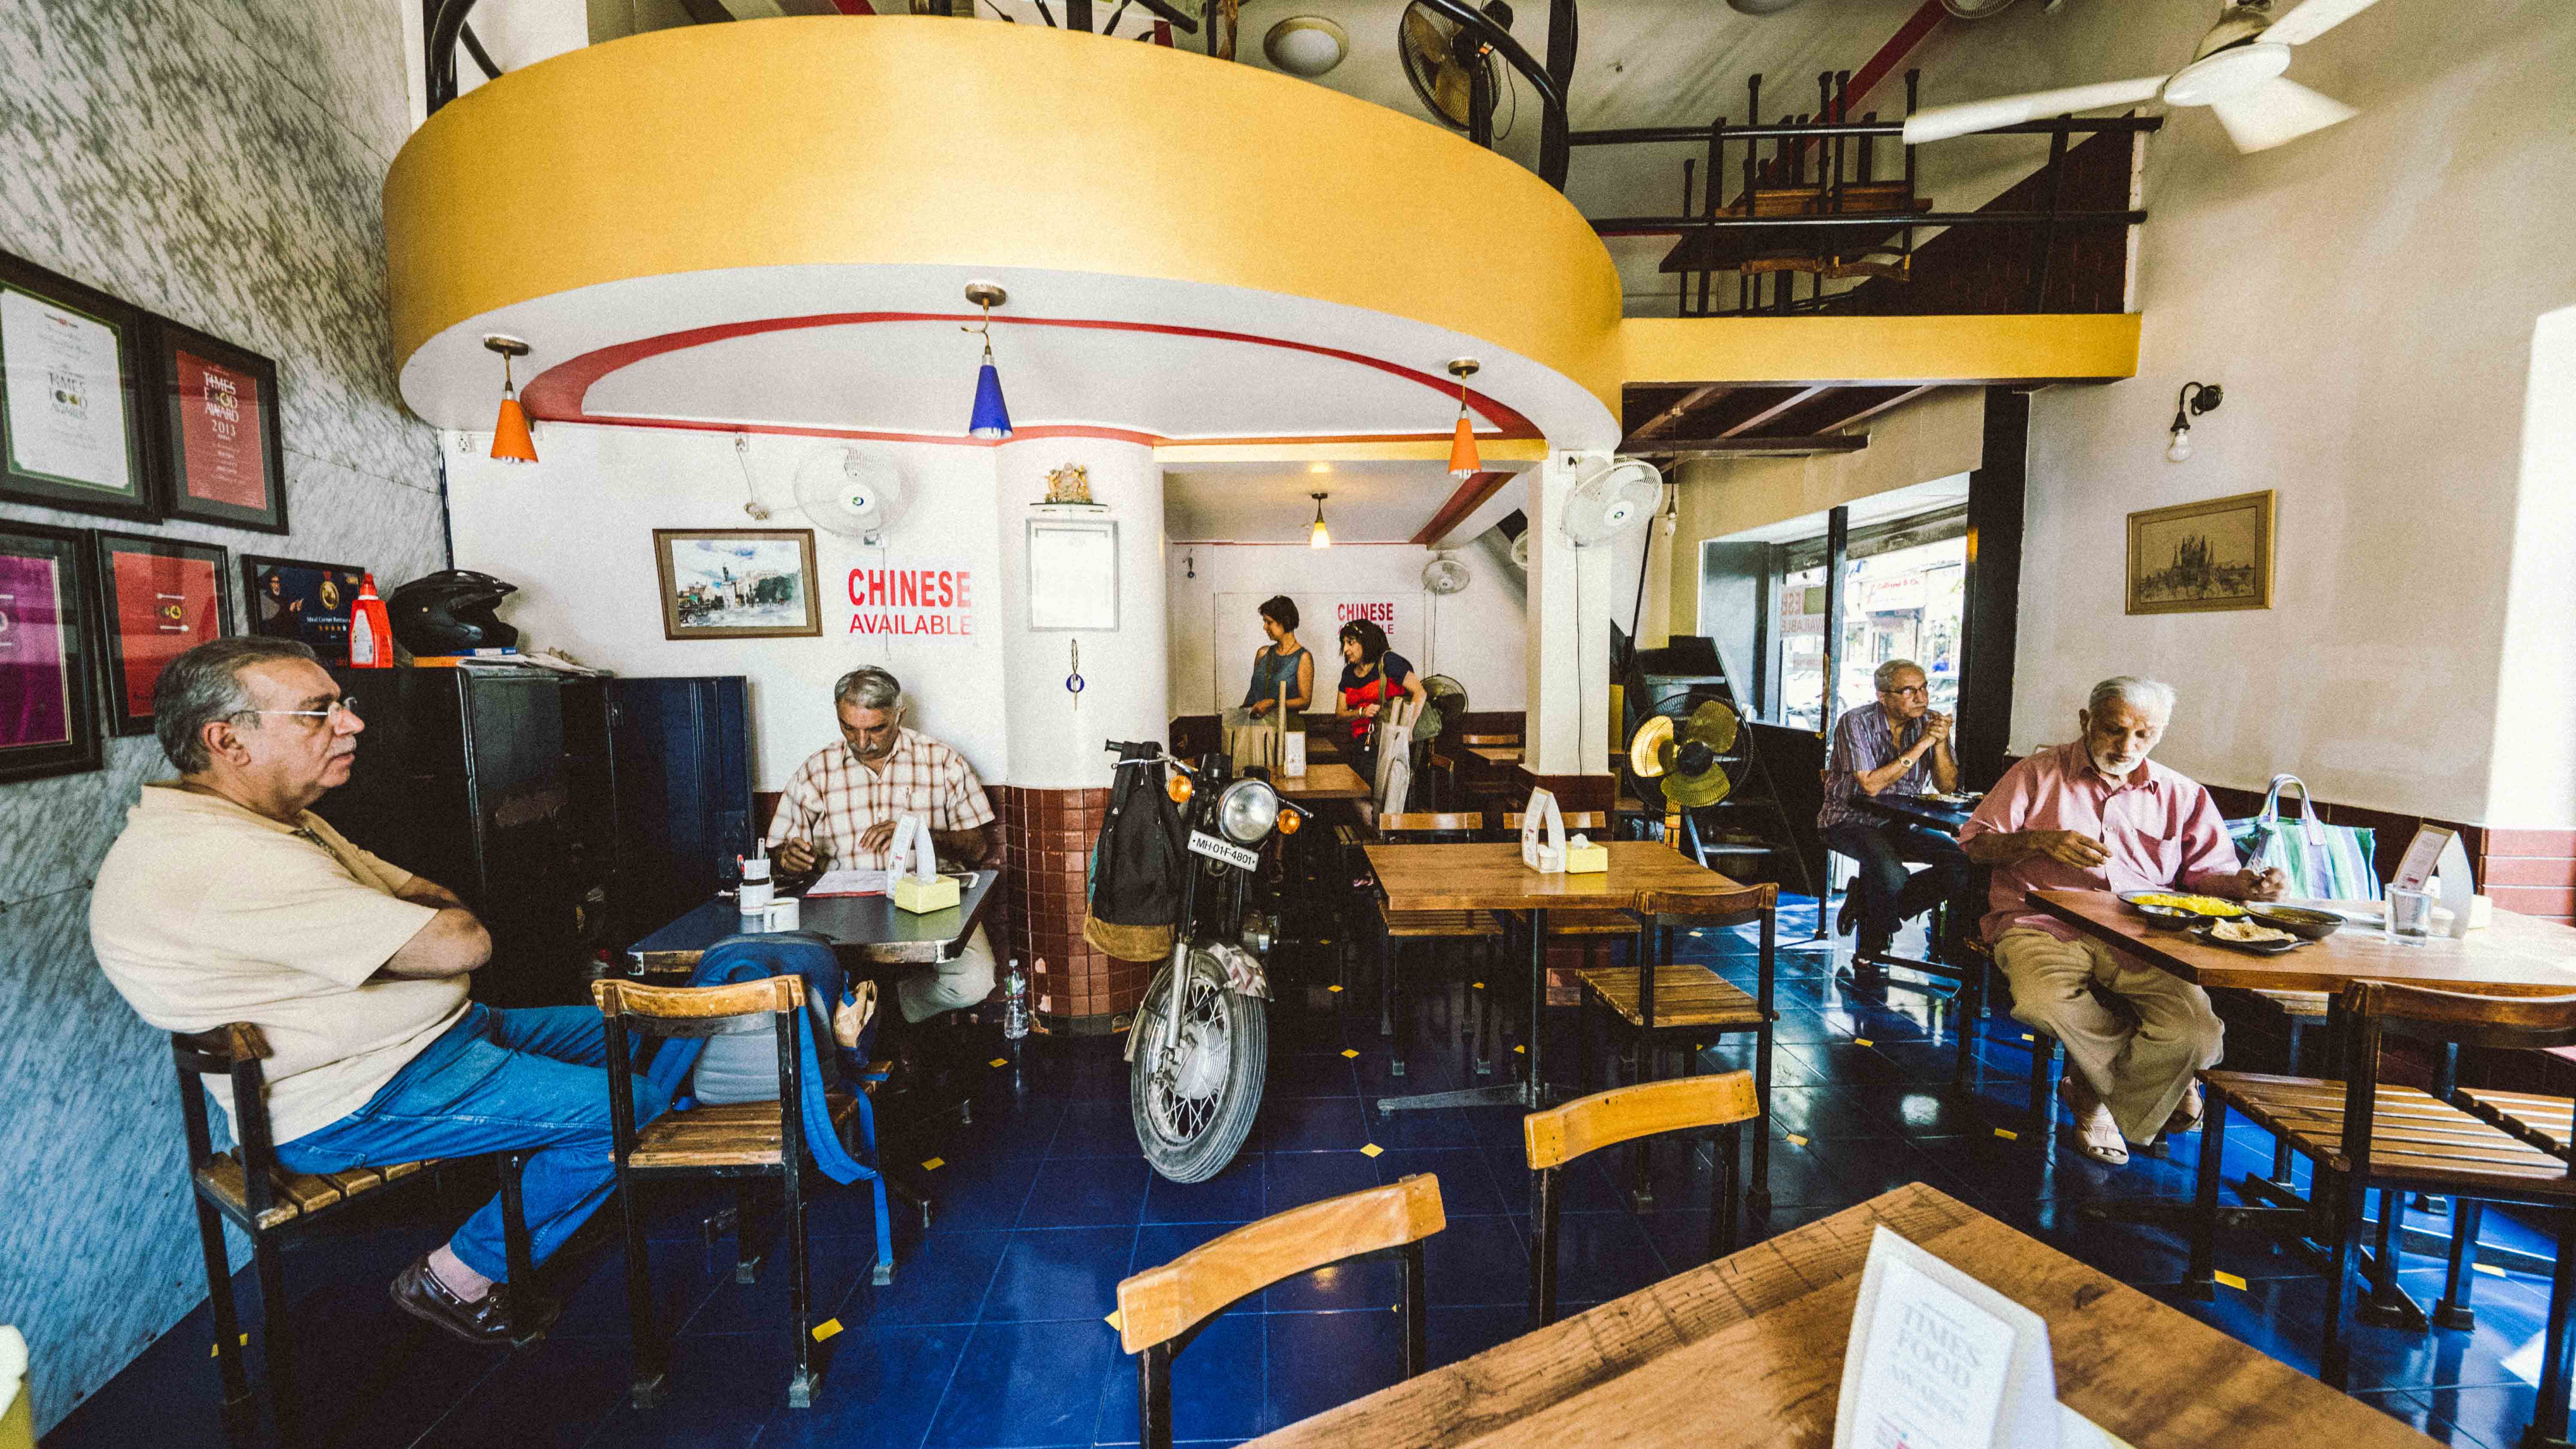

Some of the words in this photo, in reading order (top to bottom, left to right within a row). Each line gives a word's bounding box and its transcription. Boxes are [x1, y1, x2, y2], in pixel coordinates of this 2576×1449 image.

[203, 371, 236, 394] TIMES
[206, 401, 239, 422] AWARD
[212, 419, 236, 436] 2013
[848, 569, 971, 608] CHINESE
[1338, 603, 1393, 621] CHINESE
[850, 614, 972, 635] AVAILABLE
